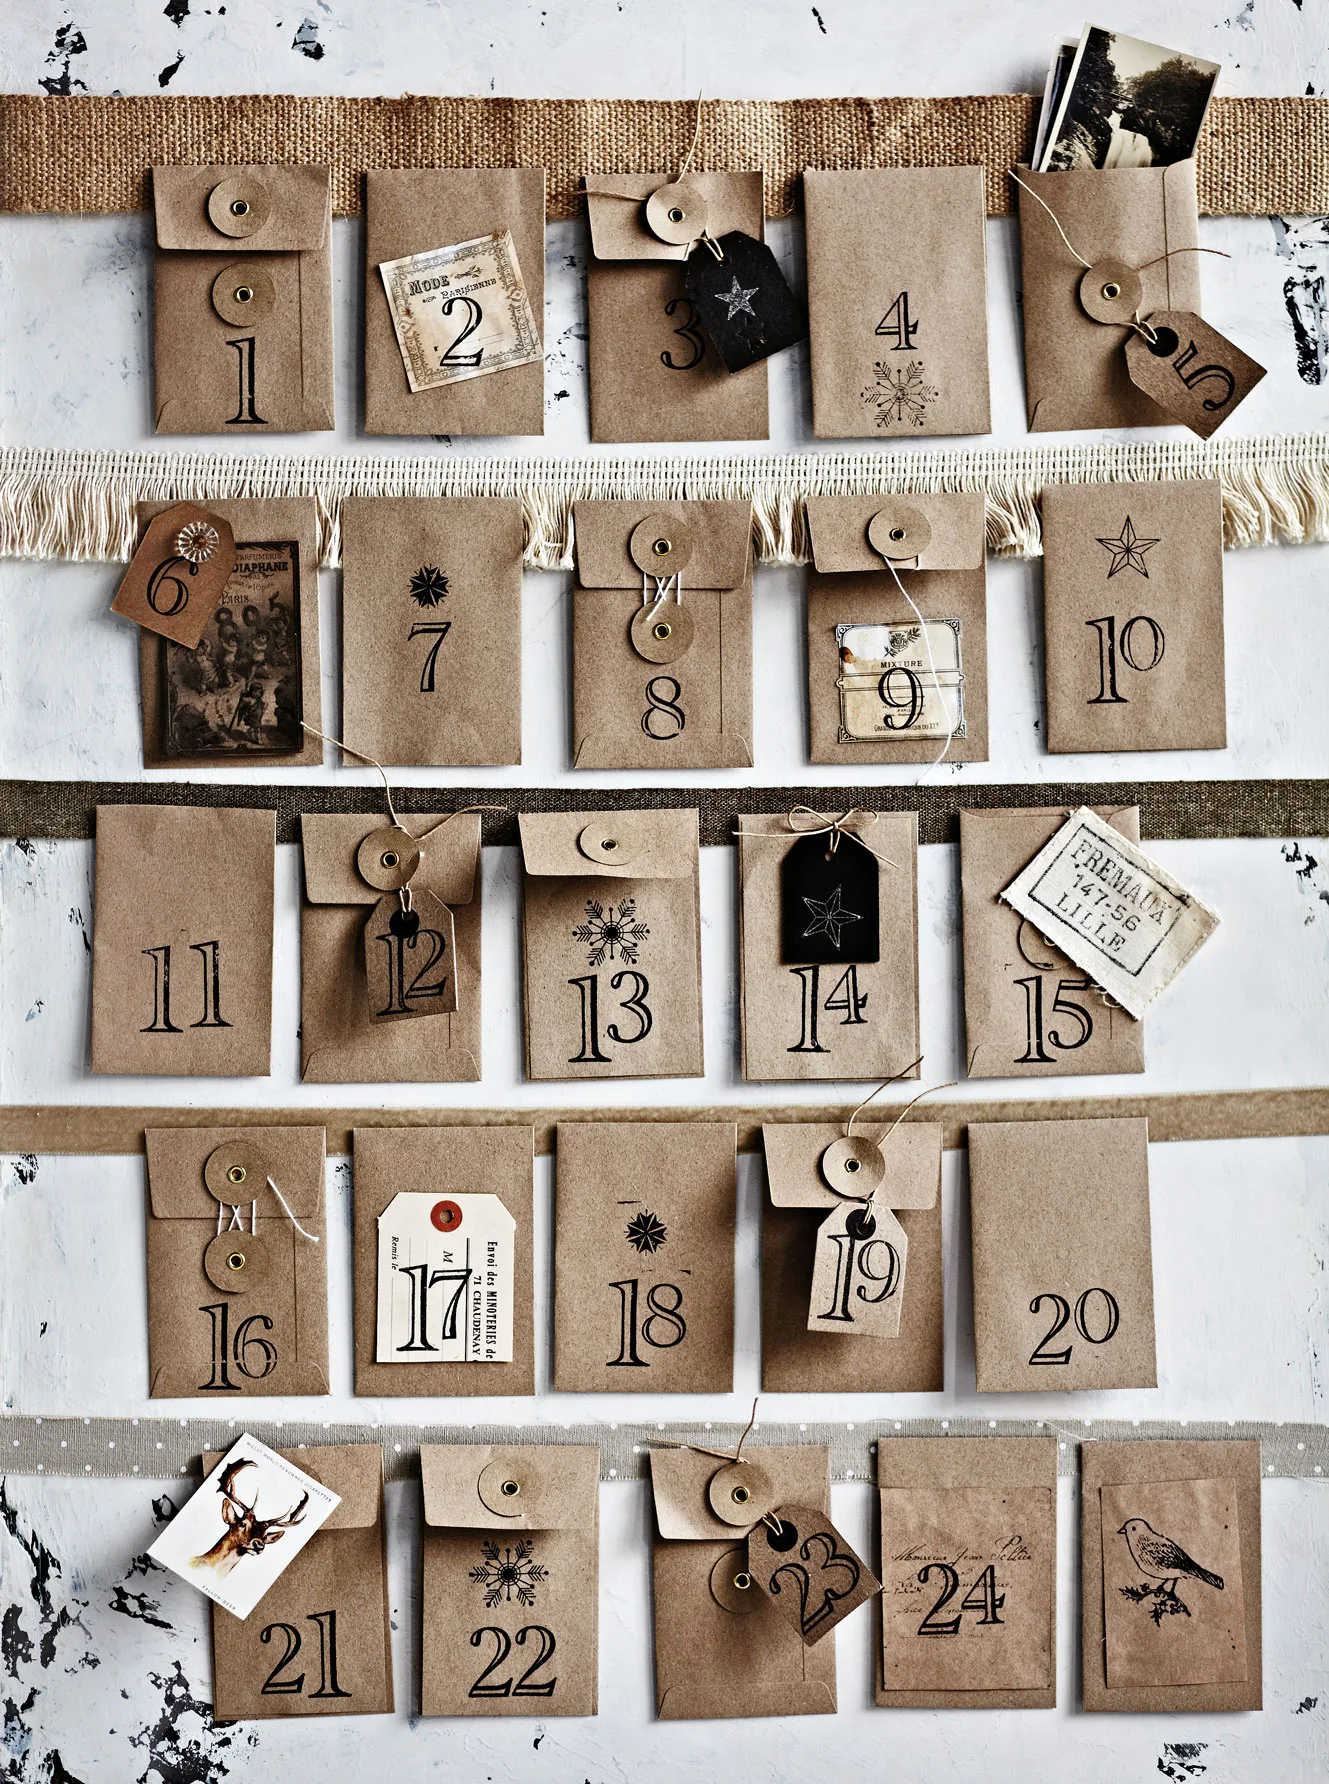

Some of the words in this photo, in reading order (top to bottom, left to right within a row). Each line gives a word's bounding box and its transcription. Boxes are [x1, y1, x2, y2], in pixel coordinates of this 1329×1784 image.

[408, 275, 450, 296] MODE
[440, 278, 498, 301] PARISIENNE
[874, 290, 919, 351] 4
[439, 296, 484, 367] 2
[660, 297, 706, 370] 3
[225, 337, 268, 425] 1
[1171, 340, 1237, 412] 5
[146, 555, 199, 617] 6
[407, 621, 452, 693] 7
[1085, 615, 1166, 704] 10
[640, 675, 686, 740] 8
[878, 667, 924, 731] 9
[1070, 839, 1173, 925] FREMAUX
[1055, 891, 1126, 953] LILLE
[140, 940, 234, 1033] 11
[375, 929, 450, 1017] 12
[787, 964, 868, 1053] 14
[567, 970, 654, 1063] 13
[1013, 975, 1093, 1063] 15
[391, 1236, 399, 1260] Remis
[391, 1262, 399, 1271] le
[442, 1250, 454, 1264] M
[473, 1275, 482, 1285] 71
[486, 1271, 498, 1287] des
[487, 1241, 498, 1267] Envoi
[816, 1233, 901, 1322] 19
[396, 1264, 473, 1351] 17
[472, 1290, 482, 1355] CHAUDENAY
[486, 1290, 498, 1345] MINOTERIES
[606, 1278, 687, 1367] 18
[1029, 1287, 1120, 1366] 20
[198, 1302, 279, 1391] 16
[485, 1347, 497, 1359] de
[770, 1532, 861, 1636] 23
[917, 1562, 1006, 1636] 24
[259, 1609, 352, 1698] 21
[468, 1625, 558, 1698] 22
